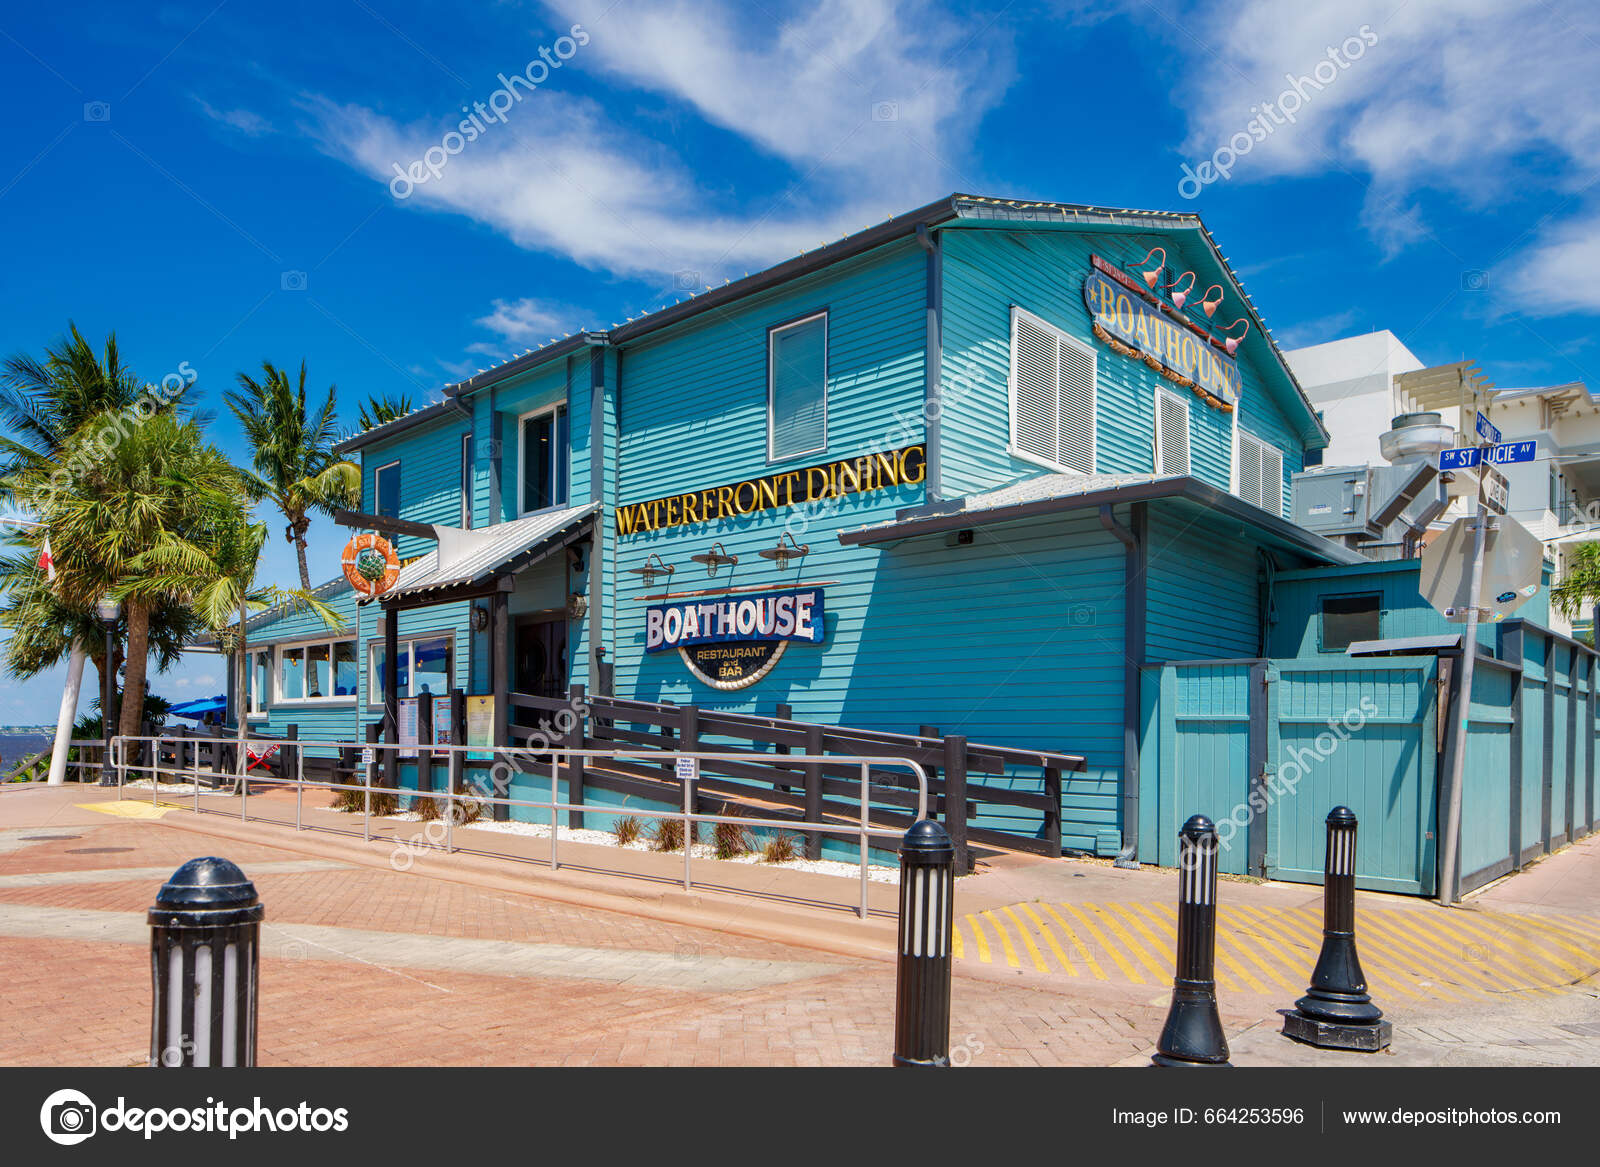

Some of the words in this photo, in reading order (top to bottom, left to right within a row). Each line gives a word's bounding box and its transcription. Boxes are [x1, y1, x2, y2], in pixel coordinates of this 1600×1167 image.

[1097, 279, 1236, 398] BOATHOUSE
[1444, 452, 1456, 461] SW
[1459, 450, 1474, 466] ST
[1520, 443, 1531, 453] AV
[615, 471, 800, 536] WATERFRONT
[804, 446, 927, 502] DINING
[647, 591, 816, 649] BOATHOUSE
[697, 646, 767, 660] RESTAURANT
[723, 659, 739, 667] and
[718, 666, 743, 677] BAR
